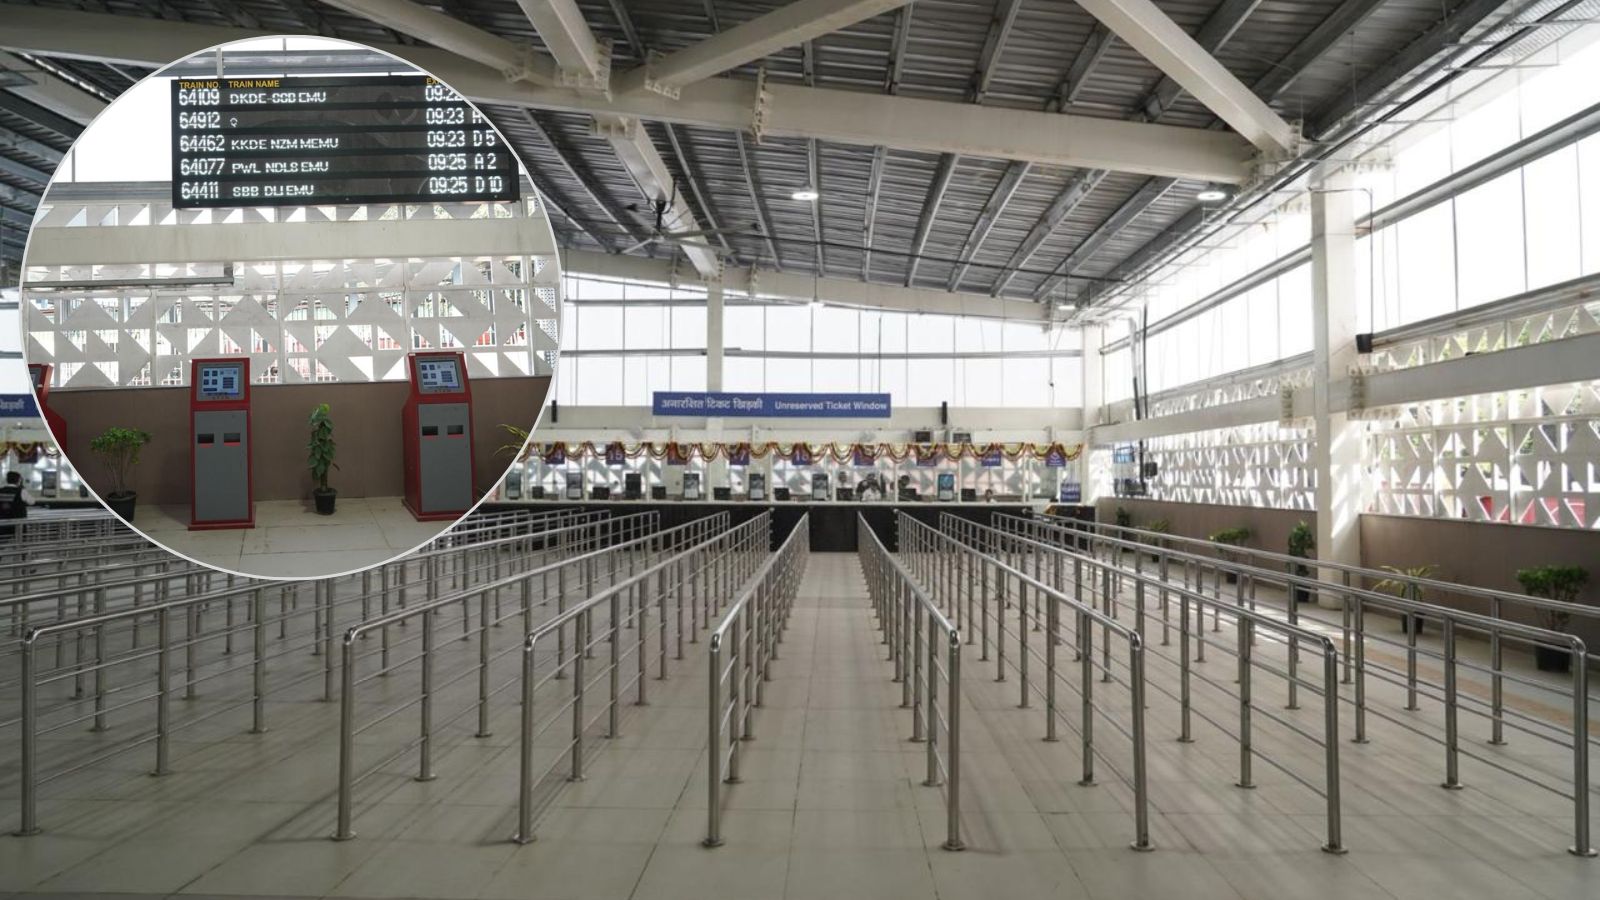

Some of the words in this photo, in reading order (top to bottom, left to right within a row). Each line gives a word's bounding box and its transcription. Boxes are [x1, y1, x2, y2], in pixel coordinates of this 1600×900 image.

[206, 81, 221, 89] NO.
[255, 80, 280, 88] NAME
[179, 89, 220, 106] 64109
[298, 91, 326, 103] EMU
[179, 111, 221, 129] 64912
[426, 107, 465, 124] 09:23
[179, 134, 226, 152] 64462
[231, 139, 268, 150] KKDE
[270, 138, 299, 149] NZM
[299, 137, 339, 149] MEMU
[427, 130, 466, 147] 09:23
[473, 130, 483, 146] D
[486, 129, 496, 146] 5
[180, 158, 226, 176] 64077
[232, 163, 262, 174] PWL
[301, 161, 329, 172] EMU
[428, 153, 467, 170] 09:25
[474, 153, 485, 170] A
[487, 152, 498, 170] 2
[181, 181, 219, 199] 64411
[232, 186, 260, 197] SBB
[285, 184, 315, 196] EMU
[429, 176, 469, 194] 09:25
[475, 176, 486, 193] D
[488, 175, 503, 193] 10
[774, 401, 824, 410] Unreserved
[826, 401, 852, 410] Ticket
[853, 401, 887, 410] Window
